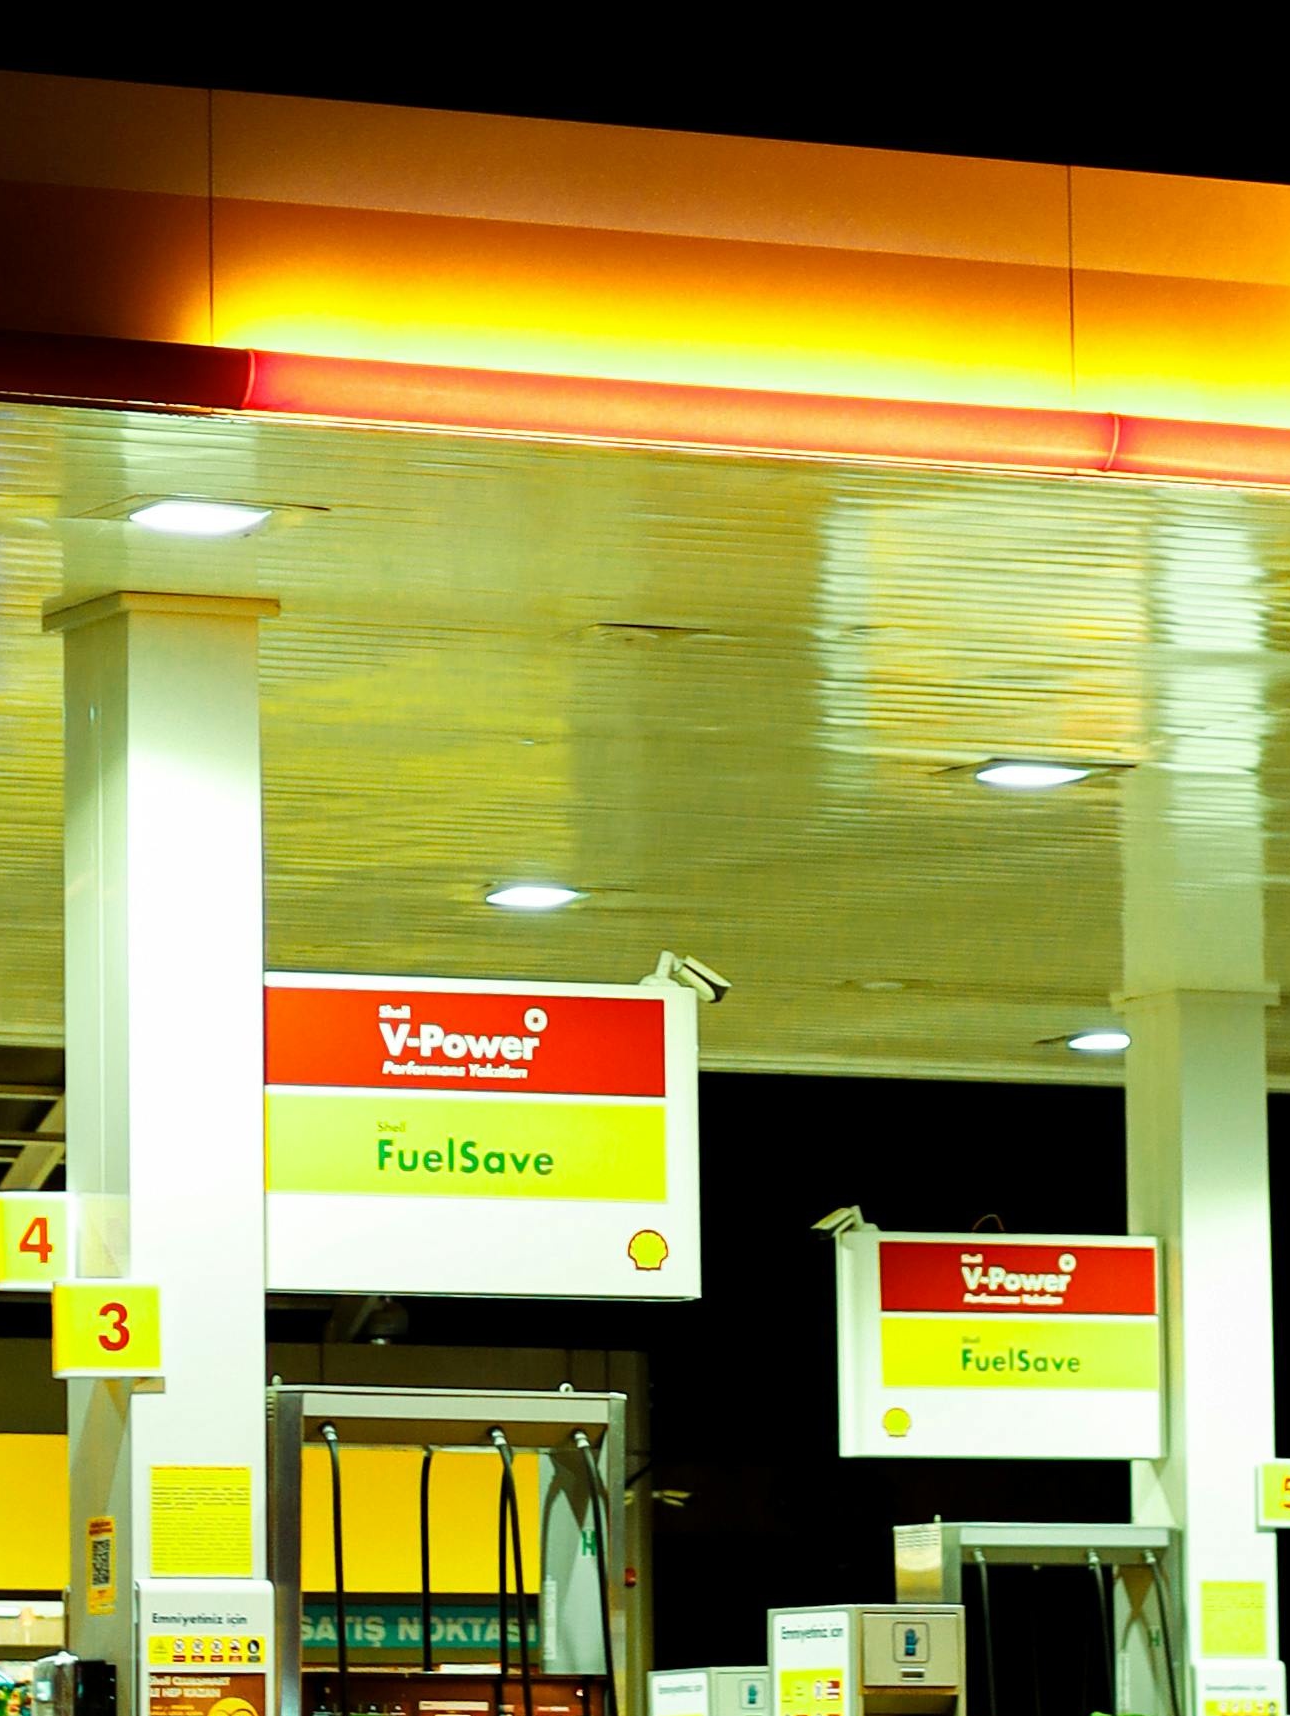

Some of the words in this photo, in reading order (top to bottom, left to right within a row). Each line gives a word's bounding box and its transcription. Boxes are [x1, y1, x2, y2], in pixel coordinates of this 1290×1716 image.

[378, 1022, 540, 1061] V-Power
[378, 1137, 554, 1176] FuelSave
[19, 1217, 53, 1264] 4
[961, 1266, 1072, 1293] V-Power
[98, 1302, 130, 1352] 3
[962, 1347, 1080, 1373] FuelSave
[152, 1612, 223, 1627] Emniyetiniz
